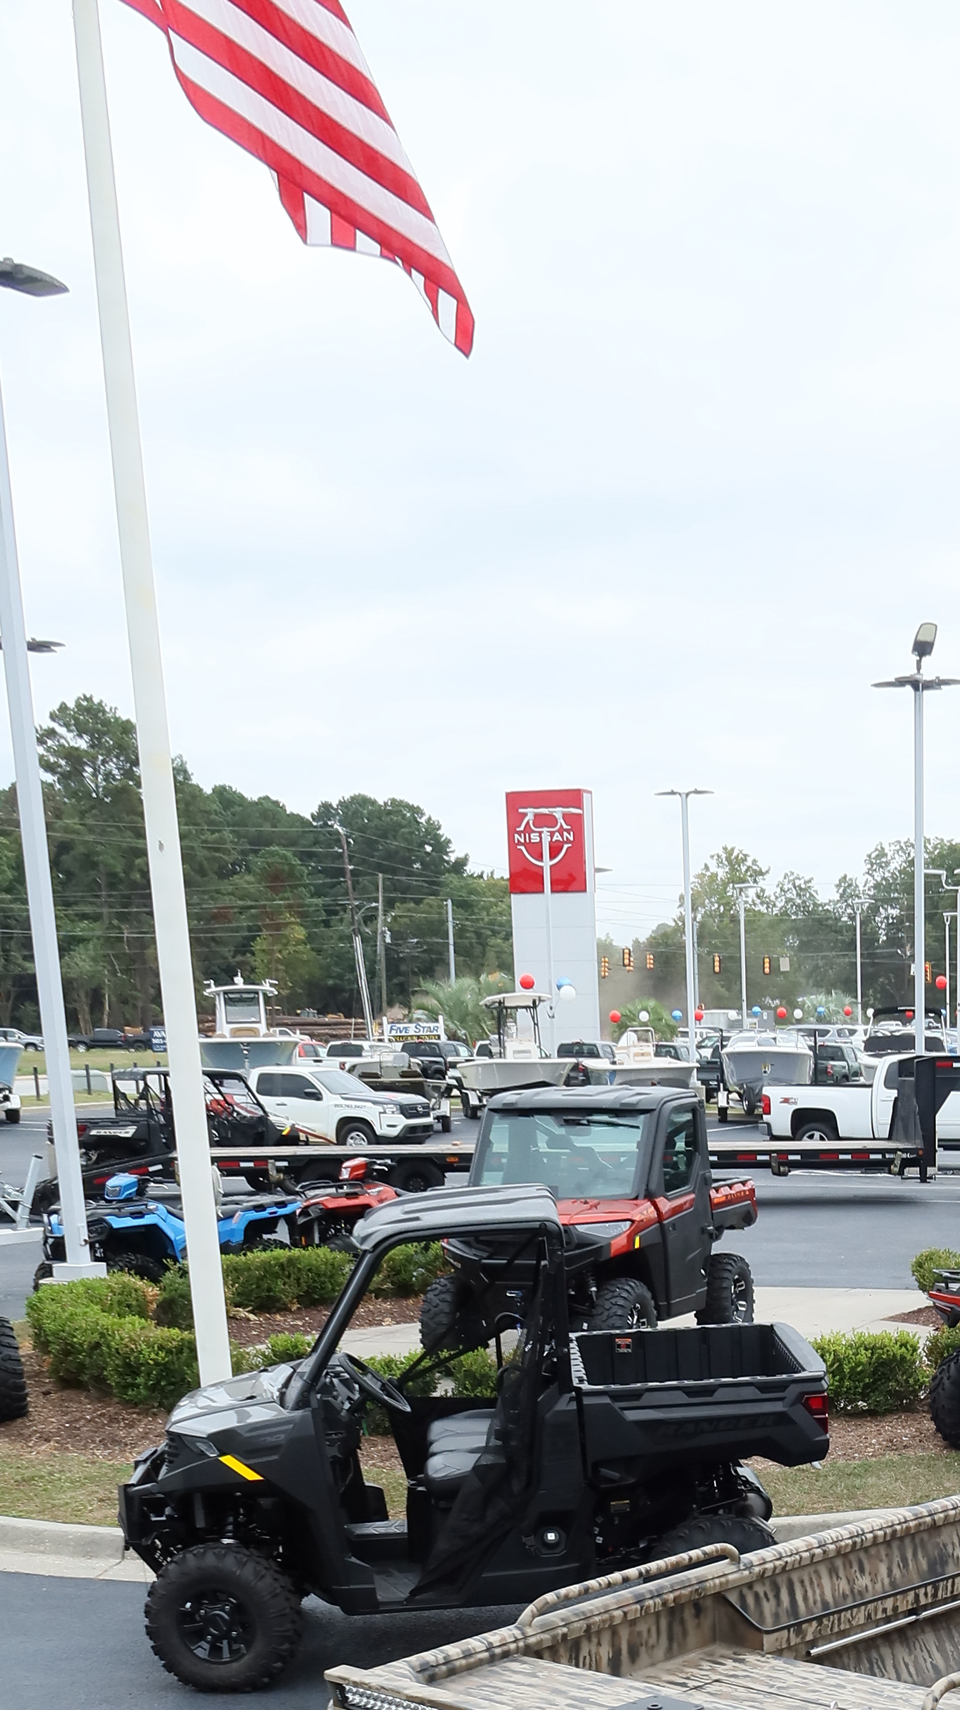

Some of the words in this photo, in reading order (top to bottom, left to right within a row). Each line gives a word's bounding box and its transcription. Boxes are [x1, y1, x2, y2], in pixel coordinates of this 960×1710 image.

[388, 1024, 410, 1034] FIVE
[414, 1023, 439, 1033] STAR
[658, 1414, 777, 1436] RANGER
